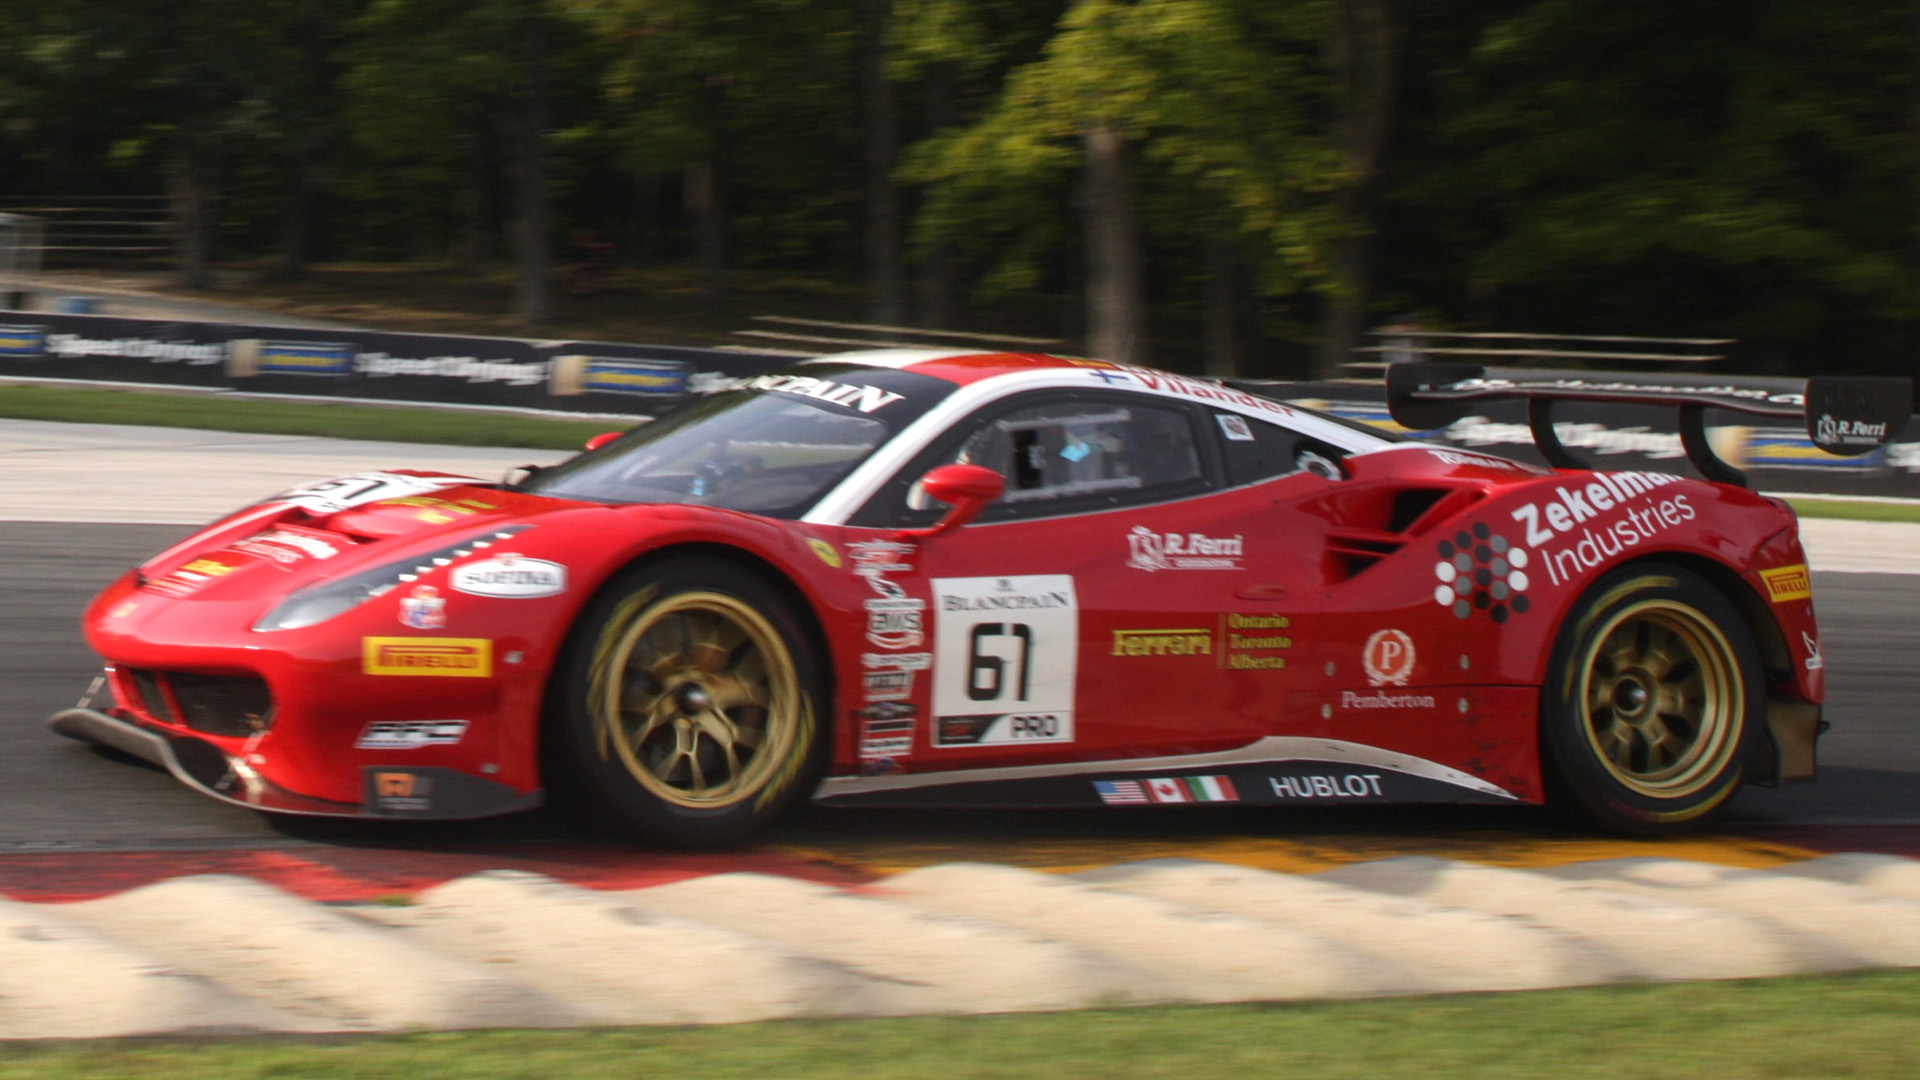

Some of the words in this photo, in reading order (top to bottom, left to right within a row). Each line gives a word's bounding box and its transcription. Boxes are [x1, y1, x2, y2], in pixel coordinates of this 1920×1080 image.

[1541, 494, 1696, 587] Industries
[1767, 571, 1807, 595] PIRELLI
[942, 591, 1070, 611] BLANCPAIN
[1110, 628, 1212, 656] Ferrari
[379, 645, 479, 669] PIRELLI
[968, 622, 1034, 702] 61
[1380, 640, 1402, 670] P
[1341, 690, 1436, 709] Pemberton
[1011, 715, 1059, 739] PRO
[1269, 774, 1383, 798] HUBLOT
